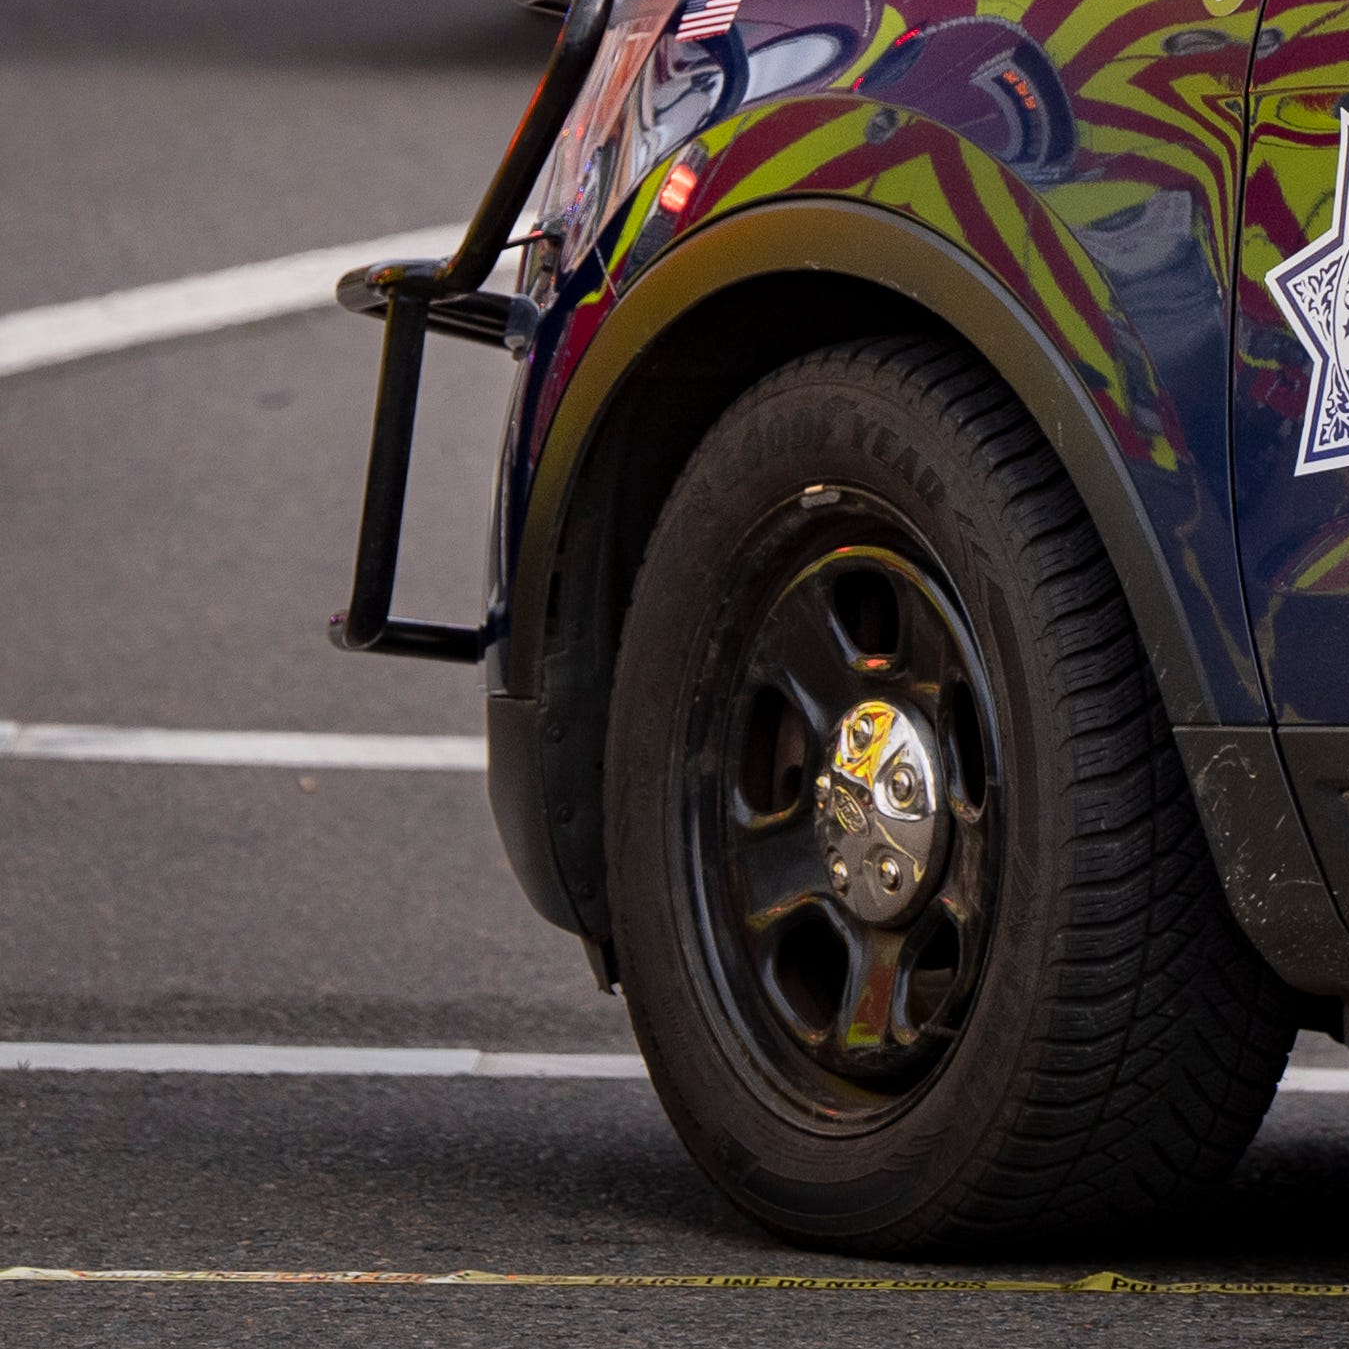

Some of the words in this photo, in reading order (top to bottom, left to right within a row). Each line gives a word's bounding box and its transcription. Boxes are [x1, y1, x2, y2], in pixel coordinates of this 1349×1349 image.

[705, 1277, 769, 1287] LINE
[777, 1279, 815, 1288] DO
[825, 1280, 885, 1288] NOT
